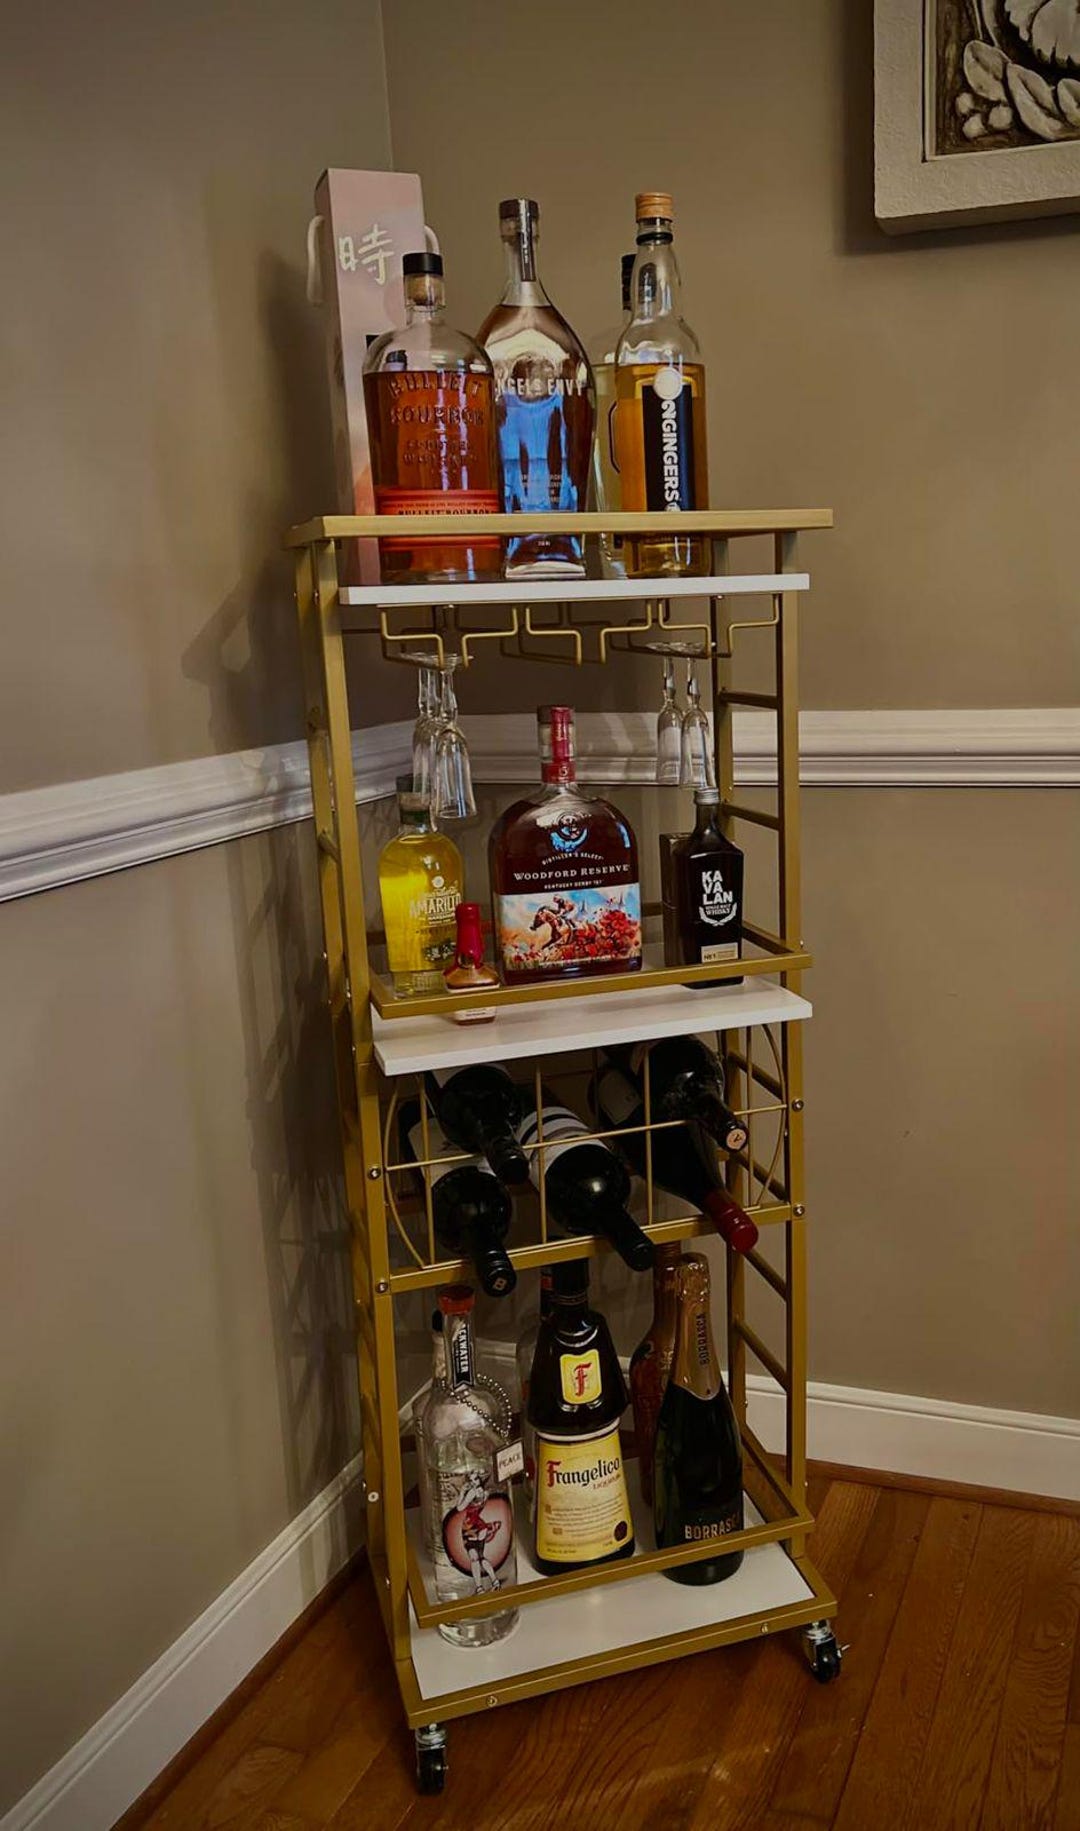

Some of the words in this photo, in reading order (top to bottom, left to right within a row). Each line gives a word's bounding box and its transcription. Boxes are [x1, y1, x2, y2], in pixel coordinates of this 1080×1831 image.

[338, 223, 395, 286] 時
[547, 374, 584, 397] ENVY
[513, 869, 577, 881] WOODFORD
[580, 863, 630, 876] RESERVE
[702, 890, 734, 906] LAN
[573, 1362, 593, 1397] F
[498, 1453, 521, 1469] PEACE
[546, 1457, 620, 1488] Frangelico
